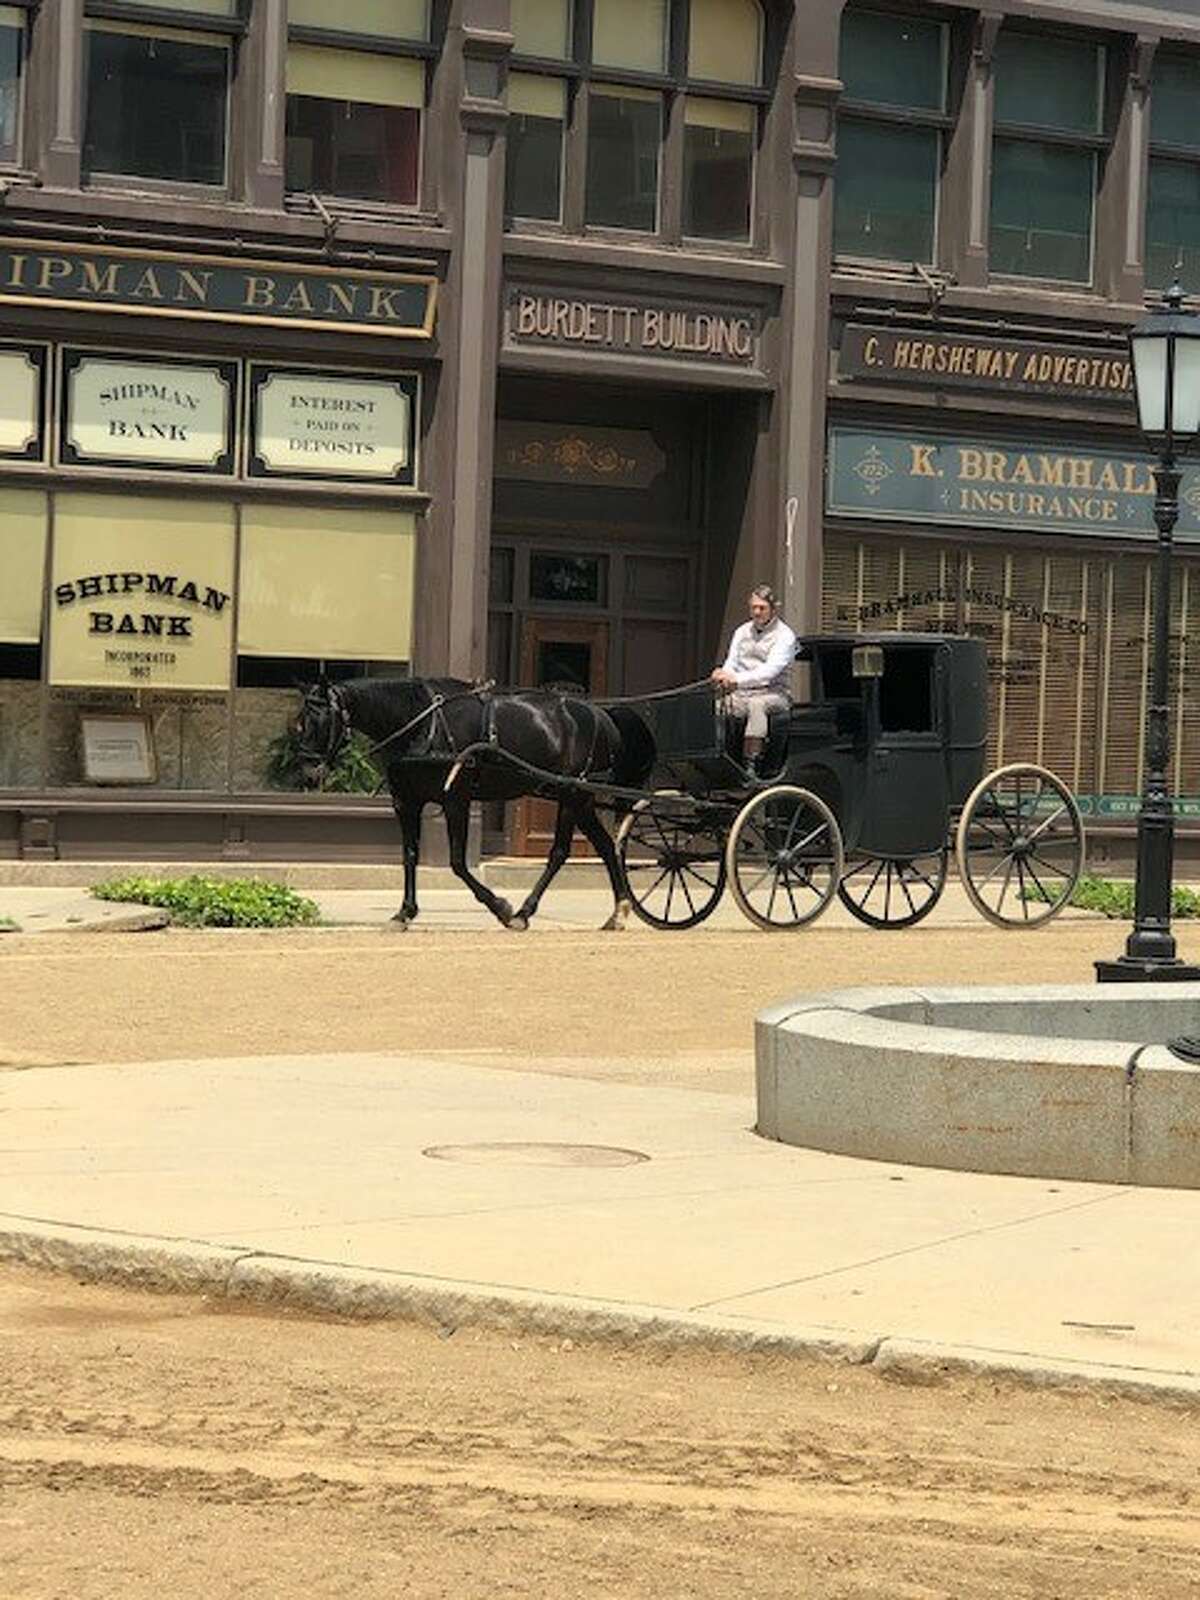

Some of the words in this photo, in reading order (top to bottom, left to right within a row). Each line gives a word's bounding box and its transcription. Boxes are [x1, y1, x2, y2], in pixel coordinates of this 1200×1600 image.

[5, 254, 214, 302] IPMAN
[244, 275, 405, 319] BANK
[518, 295, 638, 343] BURDETT
[642, 309, 752, 357] BUILDING
[864, 336, 884, 366] C.
[893, 340, 1018, 379] HERSHEWAY
[99, 384, 200, 410] SHIPMAN
[290, 395, 376, 413] INTEREST
[109, 420, 188, 441] BANK
[306, 419, 338, 431] PAID
[342, 422, 360, 431] ON
[289, 439, 375, 455] DEPOSITS
[909, 444, 943, 478] K.
[960, 488, 1118, 521] INSURANCE
[55, 572, 230, 613] SHIPMAN
[89, 611, 192, 637] BANK
[104, 649, 176, 664] INCORPORATED
